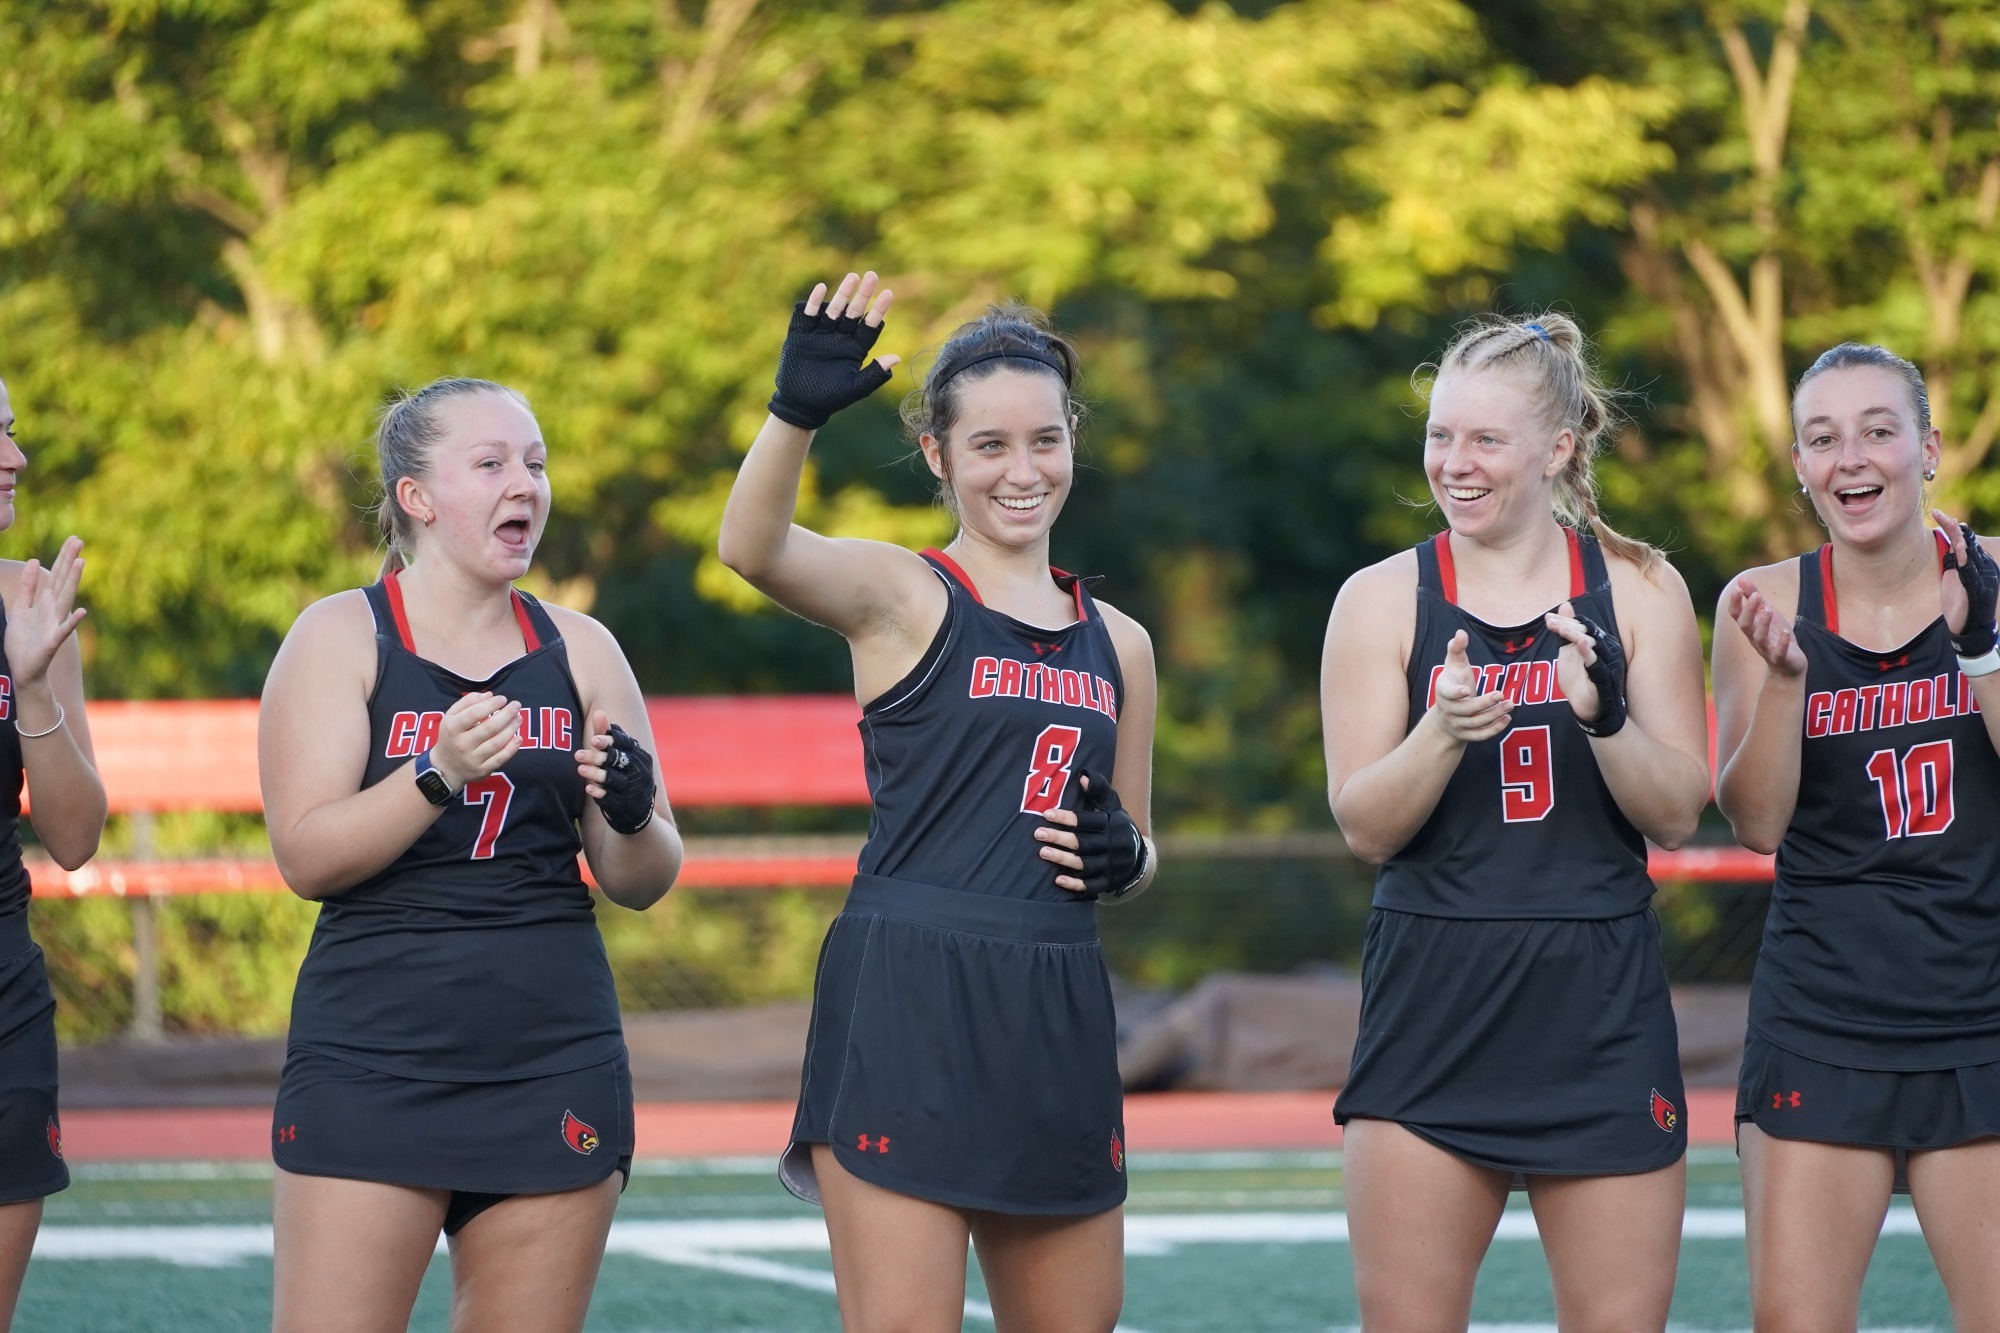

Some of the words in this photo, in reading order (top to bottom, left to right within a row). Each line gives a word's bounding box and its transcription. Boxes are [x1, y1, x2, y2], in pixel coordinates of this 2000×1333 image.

[969, 656, 1117, 724] CATHOLIC
[1426, 659, 1569, 710] THOL
[1807, 670, 1982, 738] CATHOLI
[385, 706, 573, 758] CALIC
[1020, 724, 1082, 816] 8
[1500, 725, 1554, 823] 9
[1865, 739, 1955, 841] 10
[463, 772, 516, 860] 7
